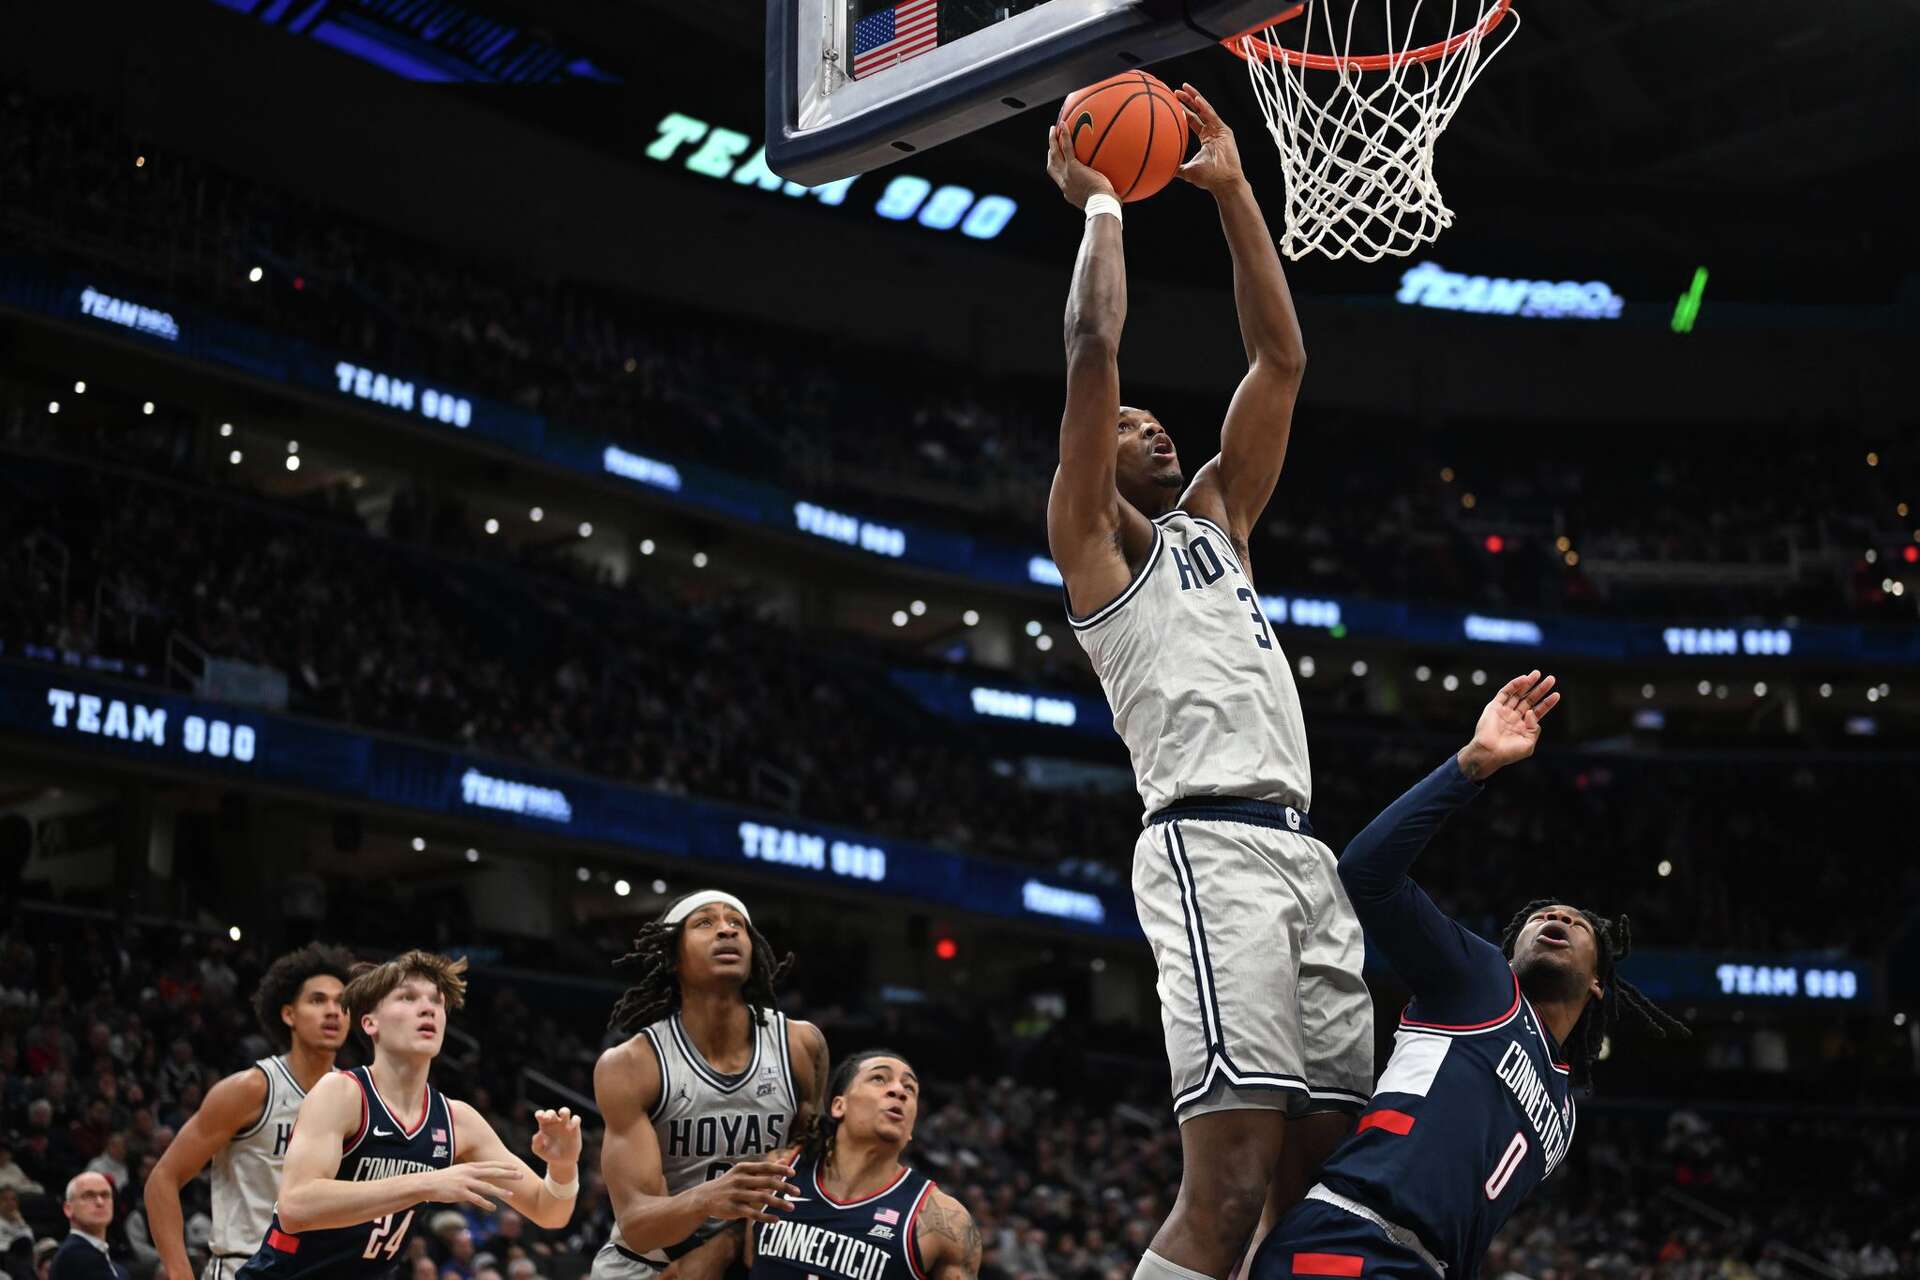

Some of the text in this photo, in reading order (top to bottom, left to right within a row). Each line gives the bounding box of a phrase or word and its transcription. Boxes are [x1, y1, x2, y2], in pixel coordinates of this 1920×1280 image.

[334, 360, 416, 412] TEAM
[48, 688, 167, 746] TEAM
[739, 821, 826, 870] TEAM
[1716, 963, 1798, 996] TEAM
[668, 1113, 785, 1157] HOYAS
[1495, 1039, 1567, 1176] CONNECTICU
[1484, 1131, 1529, 1201] 0
[757, 1219, 892, 1280] CONNECTICUT
